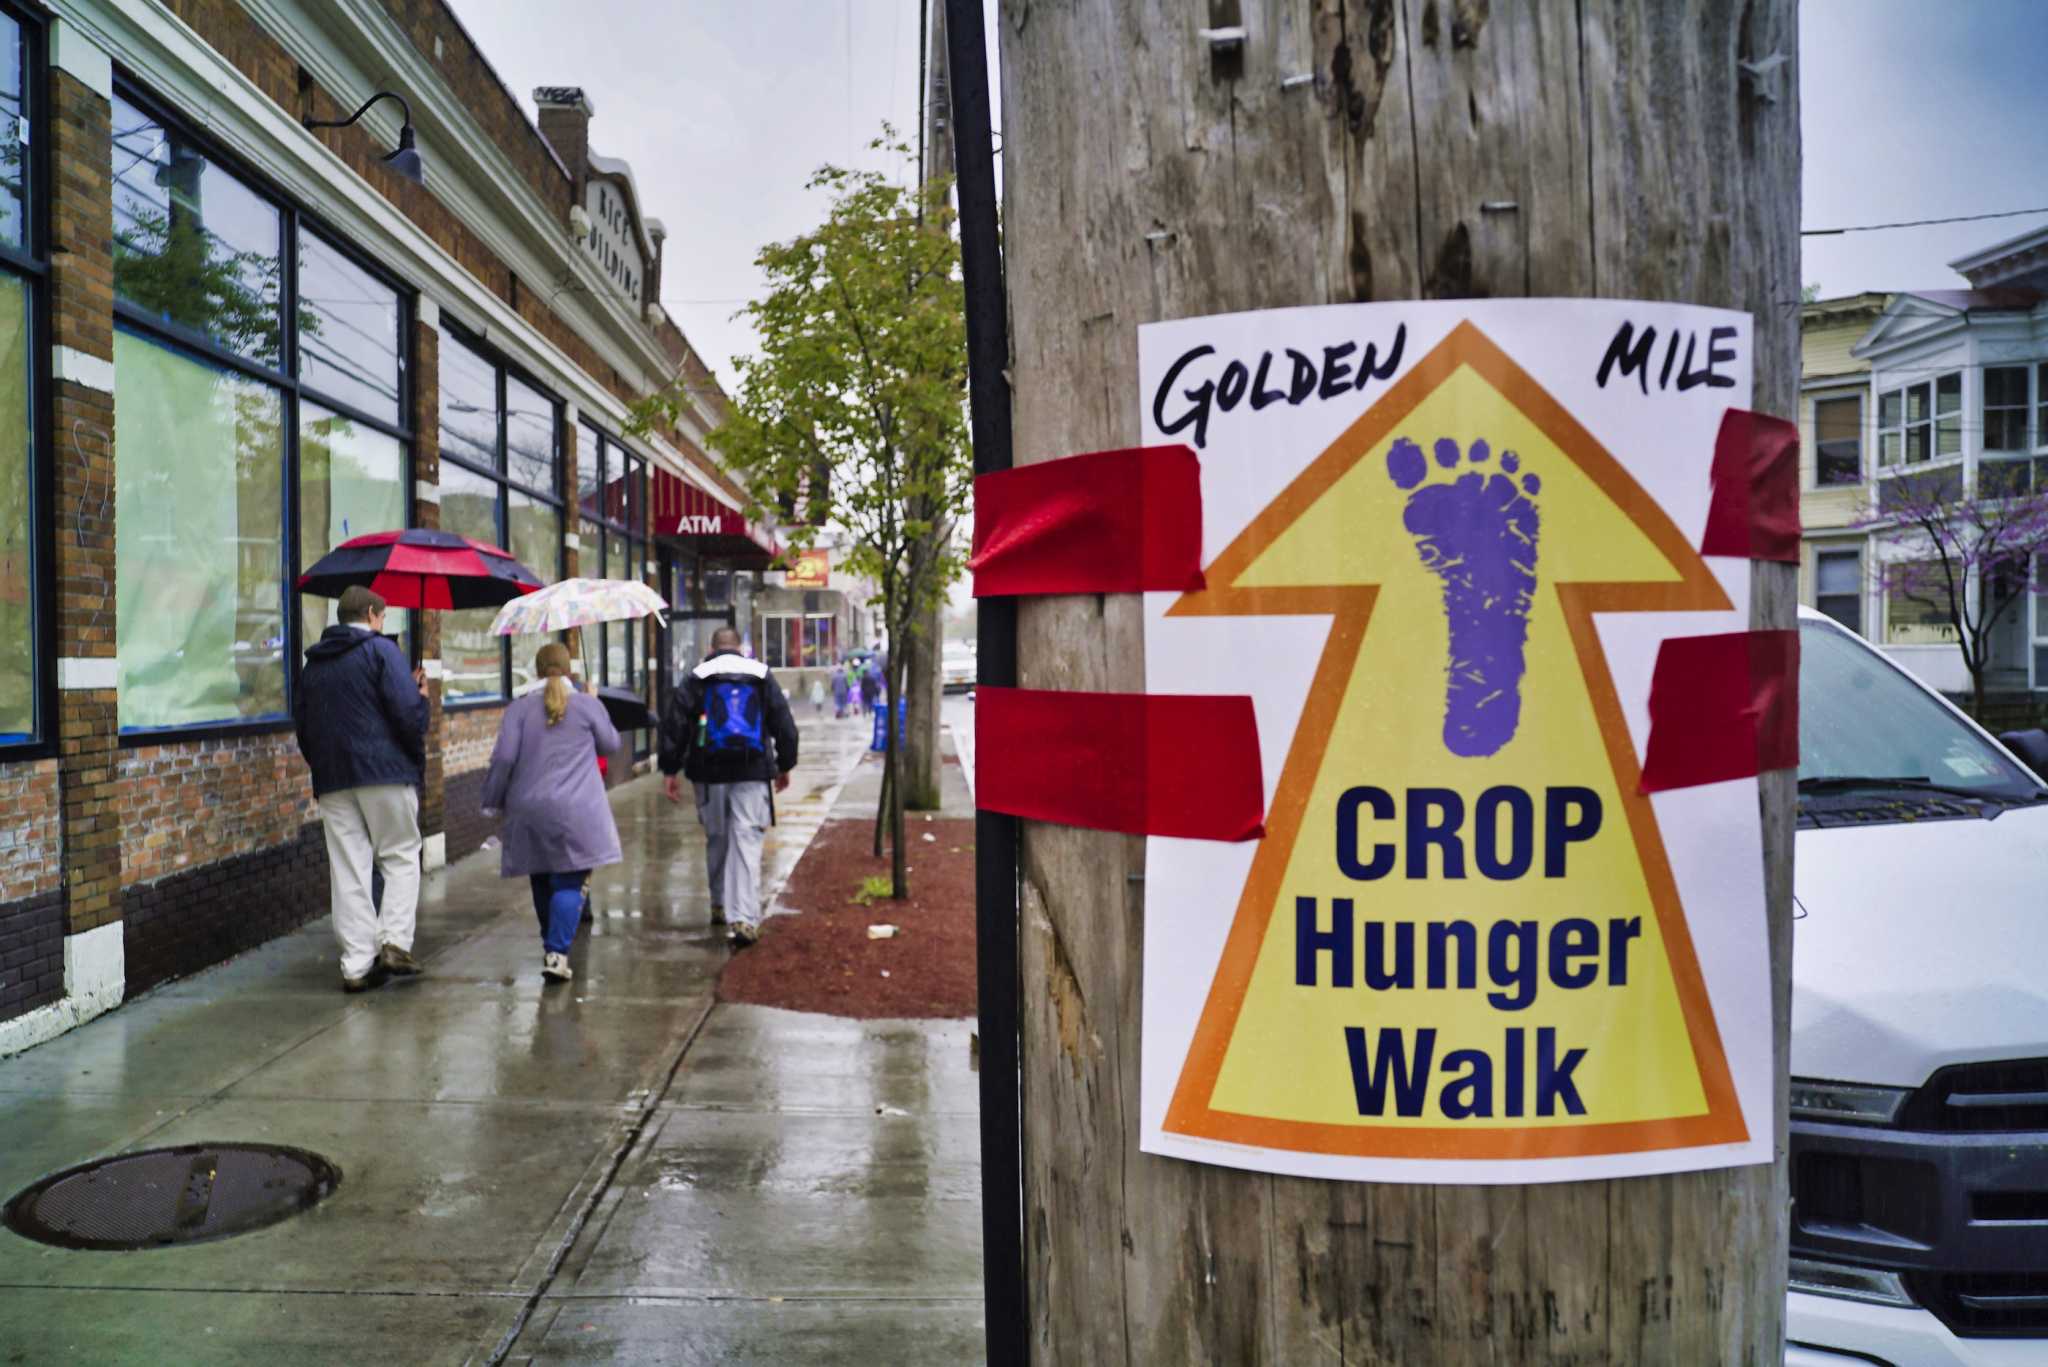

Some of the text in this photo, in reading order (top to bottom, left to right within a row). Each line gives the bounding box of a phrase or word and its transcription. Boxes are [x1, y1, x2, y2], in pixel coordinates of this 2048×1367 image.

[577, 222, 638, 302] UILDING
[600, 186, 630, 246] RICE
[1152, 321, 1738, 449] GOLDEN MILE
[677, 515, 721, 534] ATM
[1336, 785, 1603, 881] CROP
[1295, 896, 1641, 1011] Hunger
[1344, 1027, 1588, 1119] Walk
